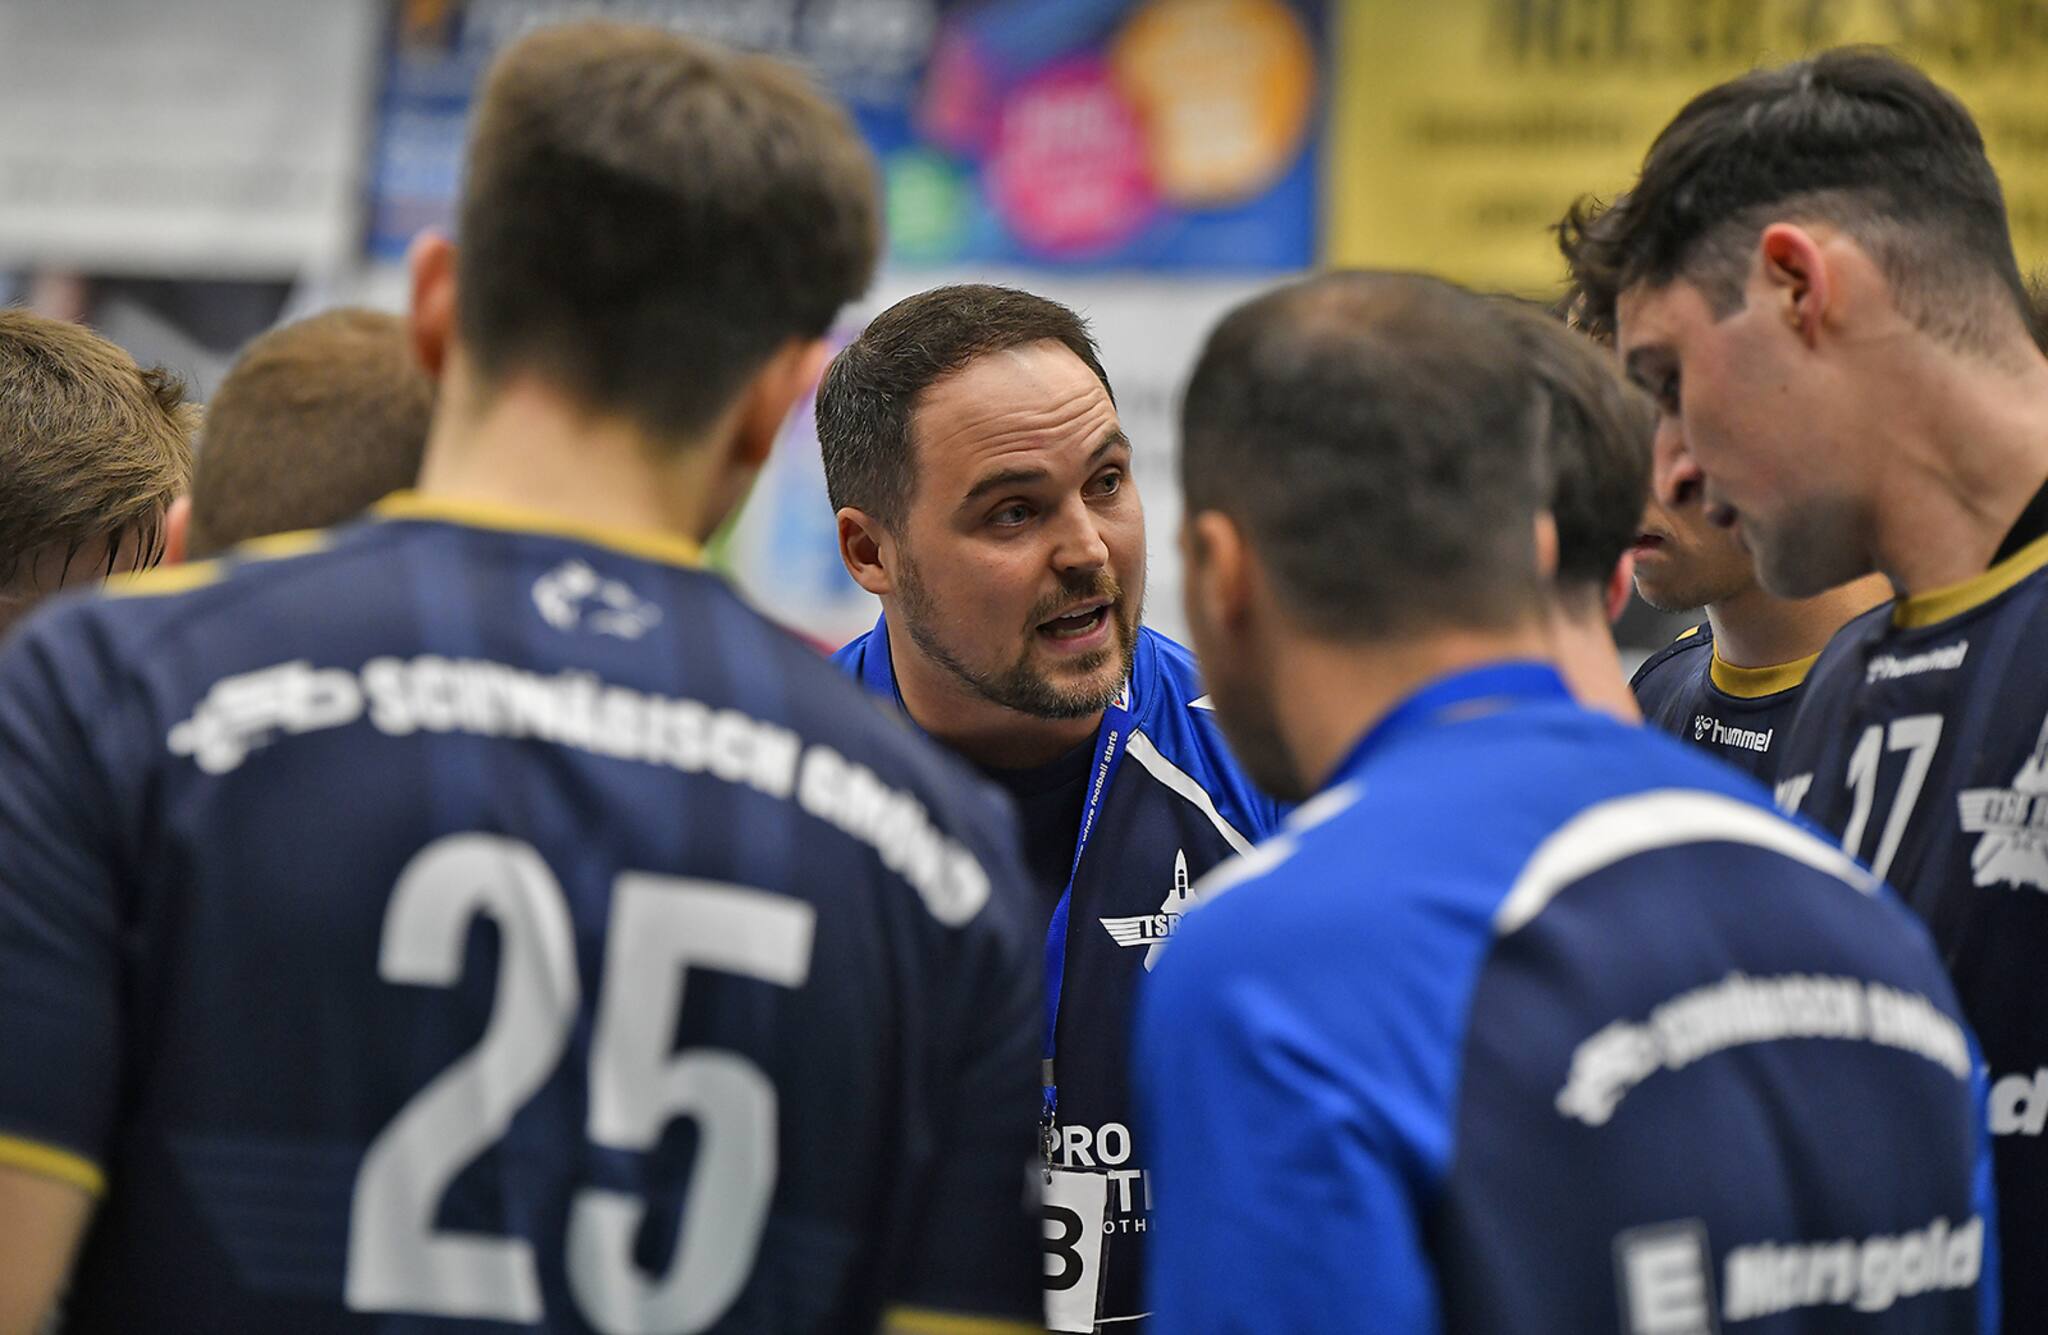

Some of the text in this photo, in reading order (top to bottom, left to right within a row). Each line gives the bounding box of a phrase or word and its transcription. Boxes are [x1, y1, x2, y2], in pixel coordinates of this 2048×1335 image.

[1083, 730, 1119, 841] where football starts
[1712, 719, 1773, 752] hummel
[1842, 713, 1944, 886] 17
[345, 831, 818, 1335] 25
